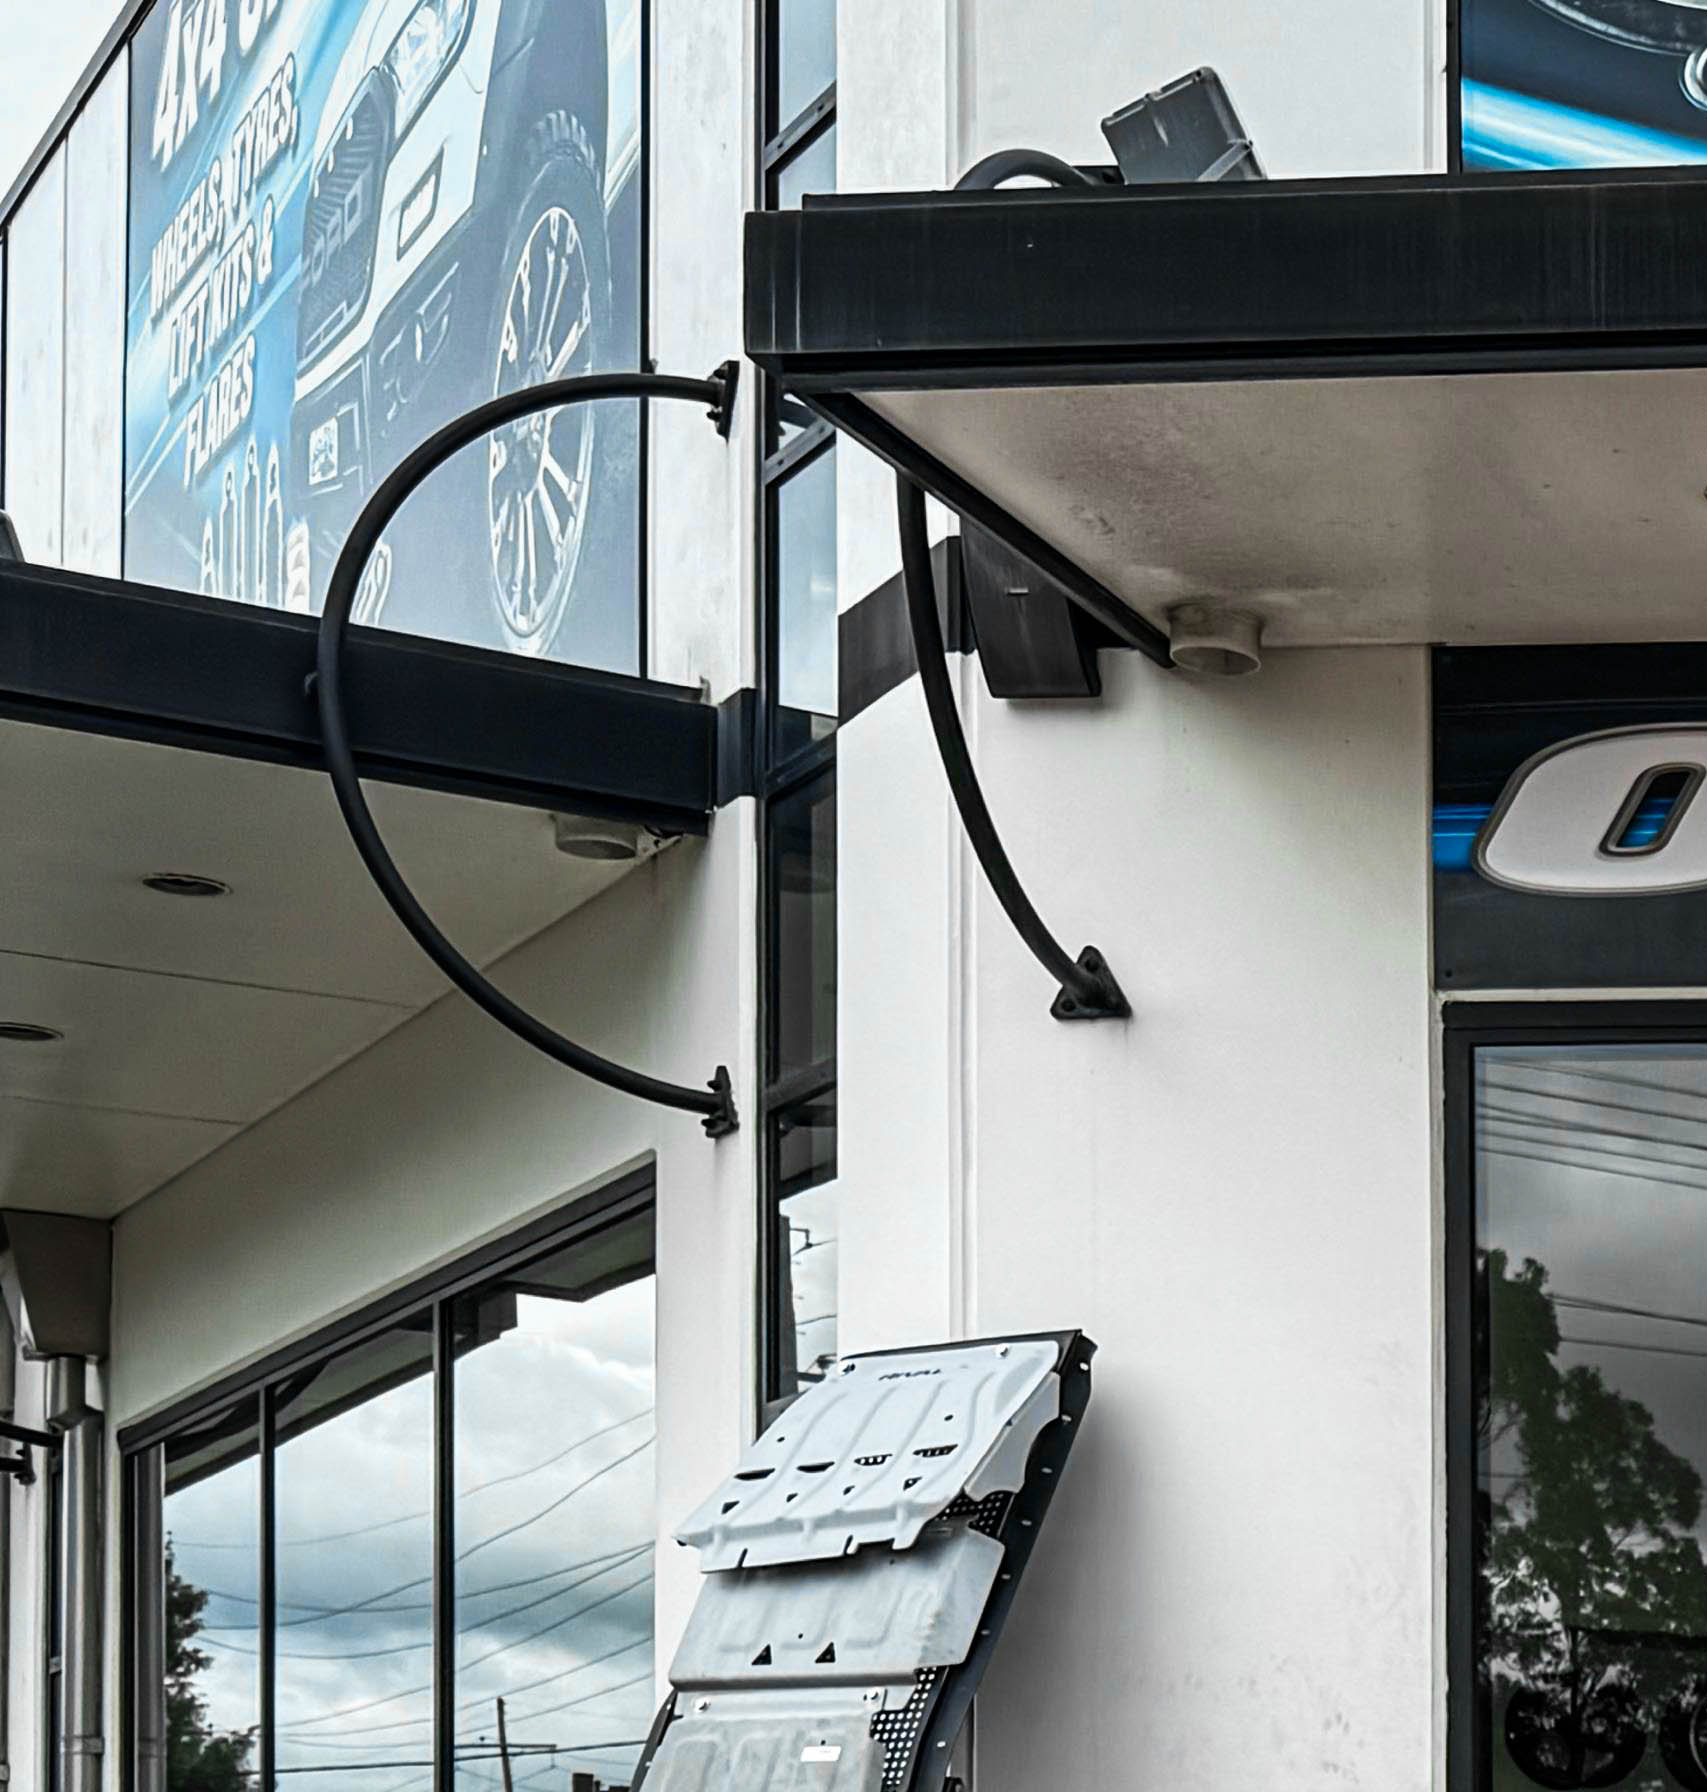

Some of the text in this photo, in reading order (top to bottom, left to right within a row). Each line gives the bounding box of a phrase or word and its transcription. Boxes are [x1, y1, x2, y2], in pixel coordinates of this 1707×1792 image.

[150, 157, 224, 323] WHEELS,
[232, 53, 299, 218] TYRES,
[168, 193, 273, 401] LIFT KITS &
[184, 333, 255, 482] FLARES
